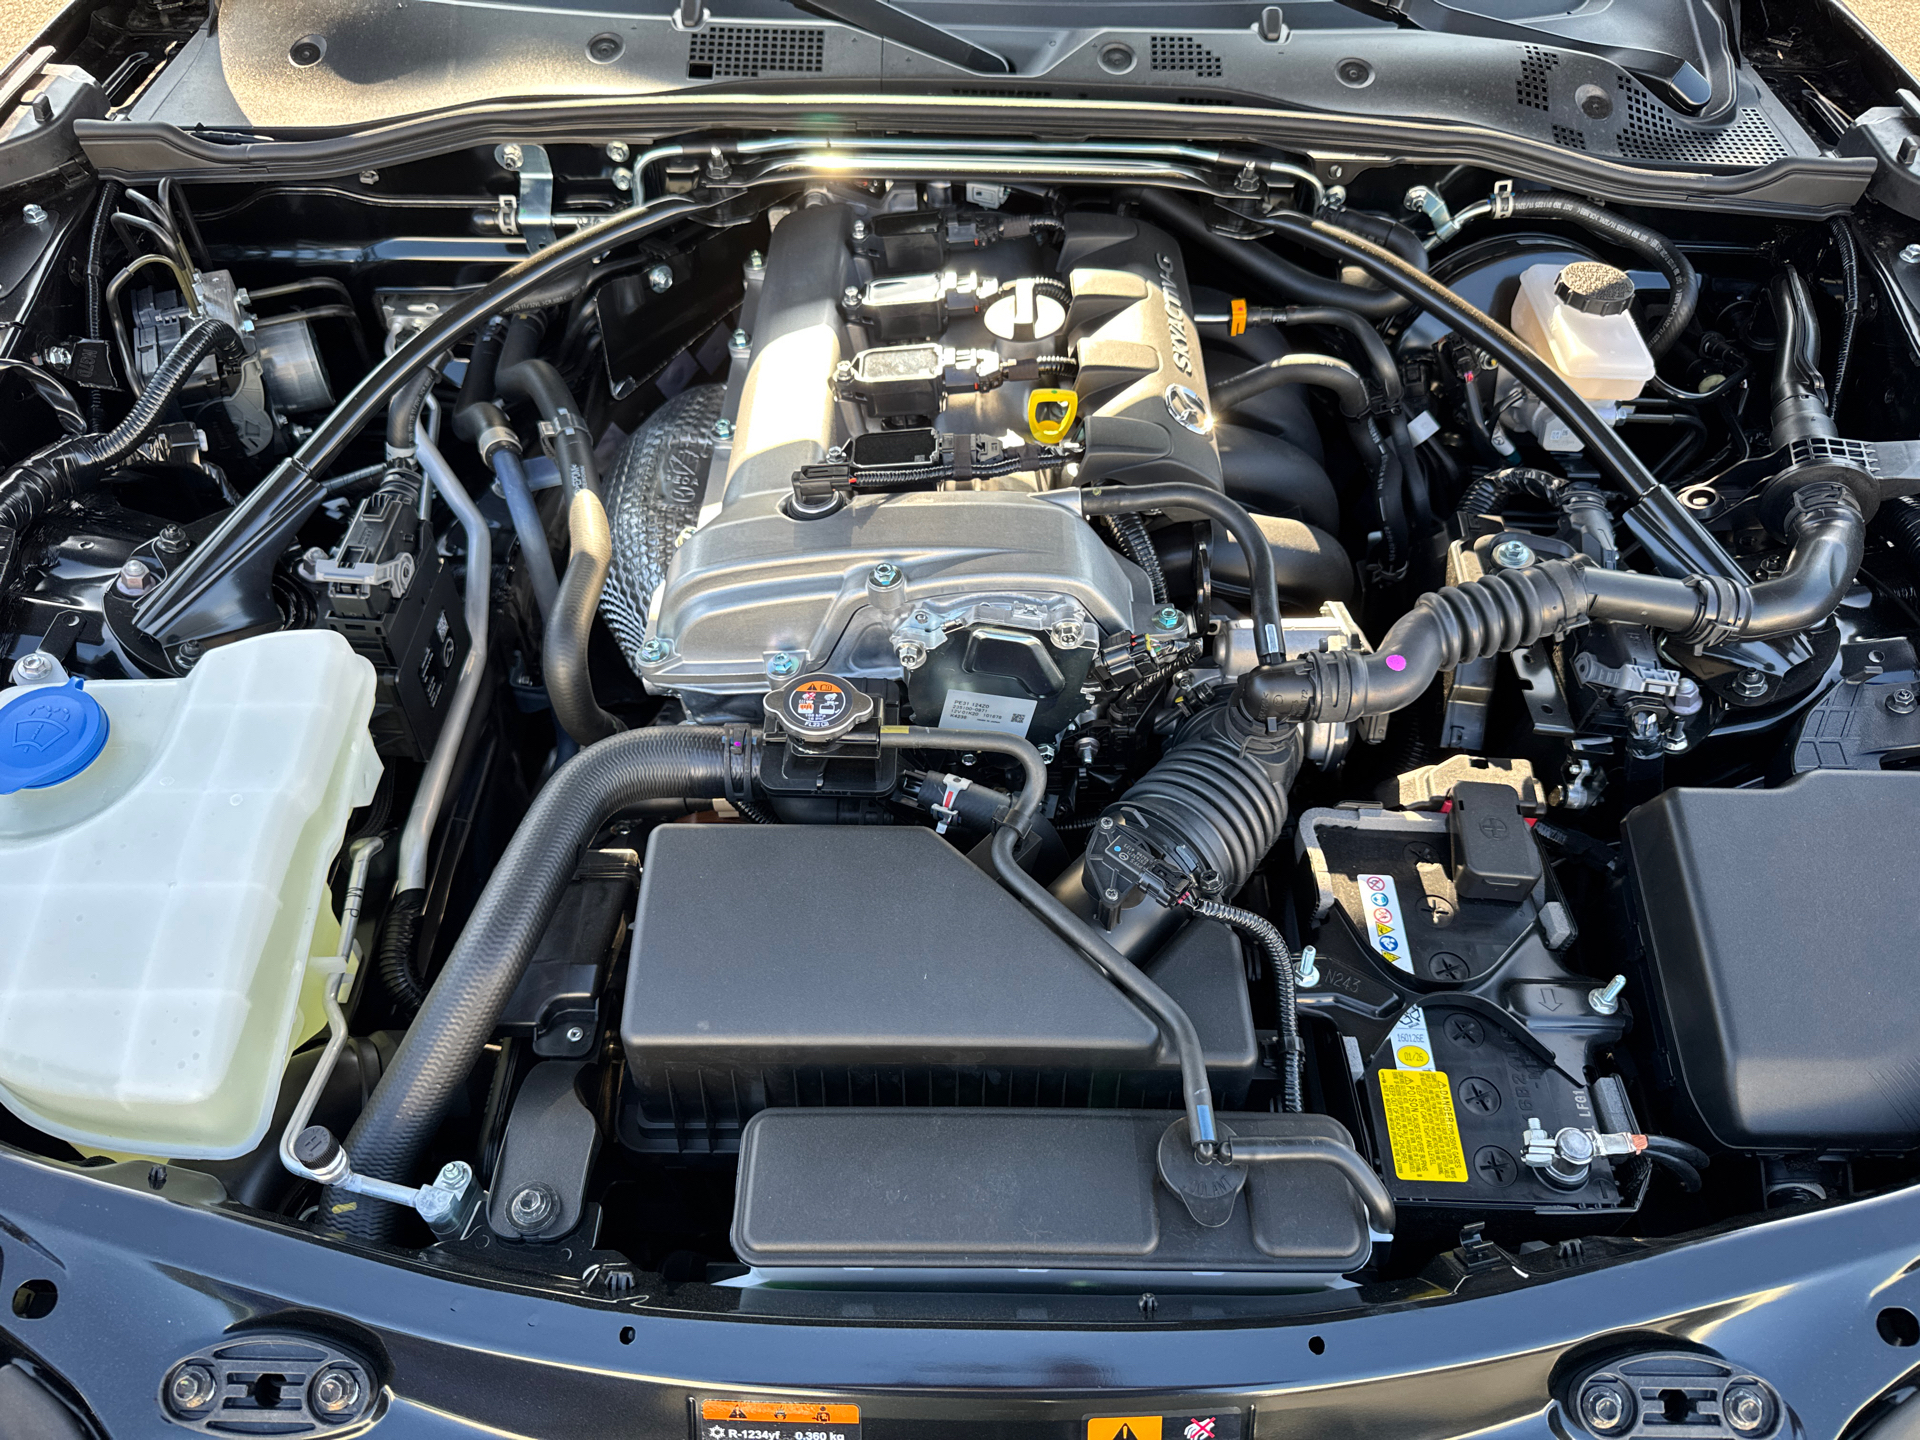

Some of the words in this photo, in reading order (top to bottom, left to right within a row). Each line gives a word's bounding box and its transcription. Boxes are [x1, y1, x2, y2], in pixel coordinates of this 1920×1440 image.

[1156, 253, 1193, 378] SKYACTIV-G
[1325, 969, 1361, 993] N243
[1403, 1052, 1424, 1062] 01/26
[1406, 1085, 1419, 1112] POISON
[1439, 1090, 1454, 1122] DANGER
[728, 1429, 780, 1440] R-1234yf
[794, 1431, 827, 1440] 0.360
